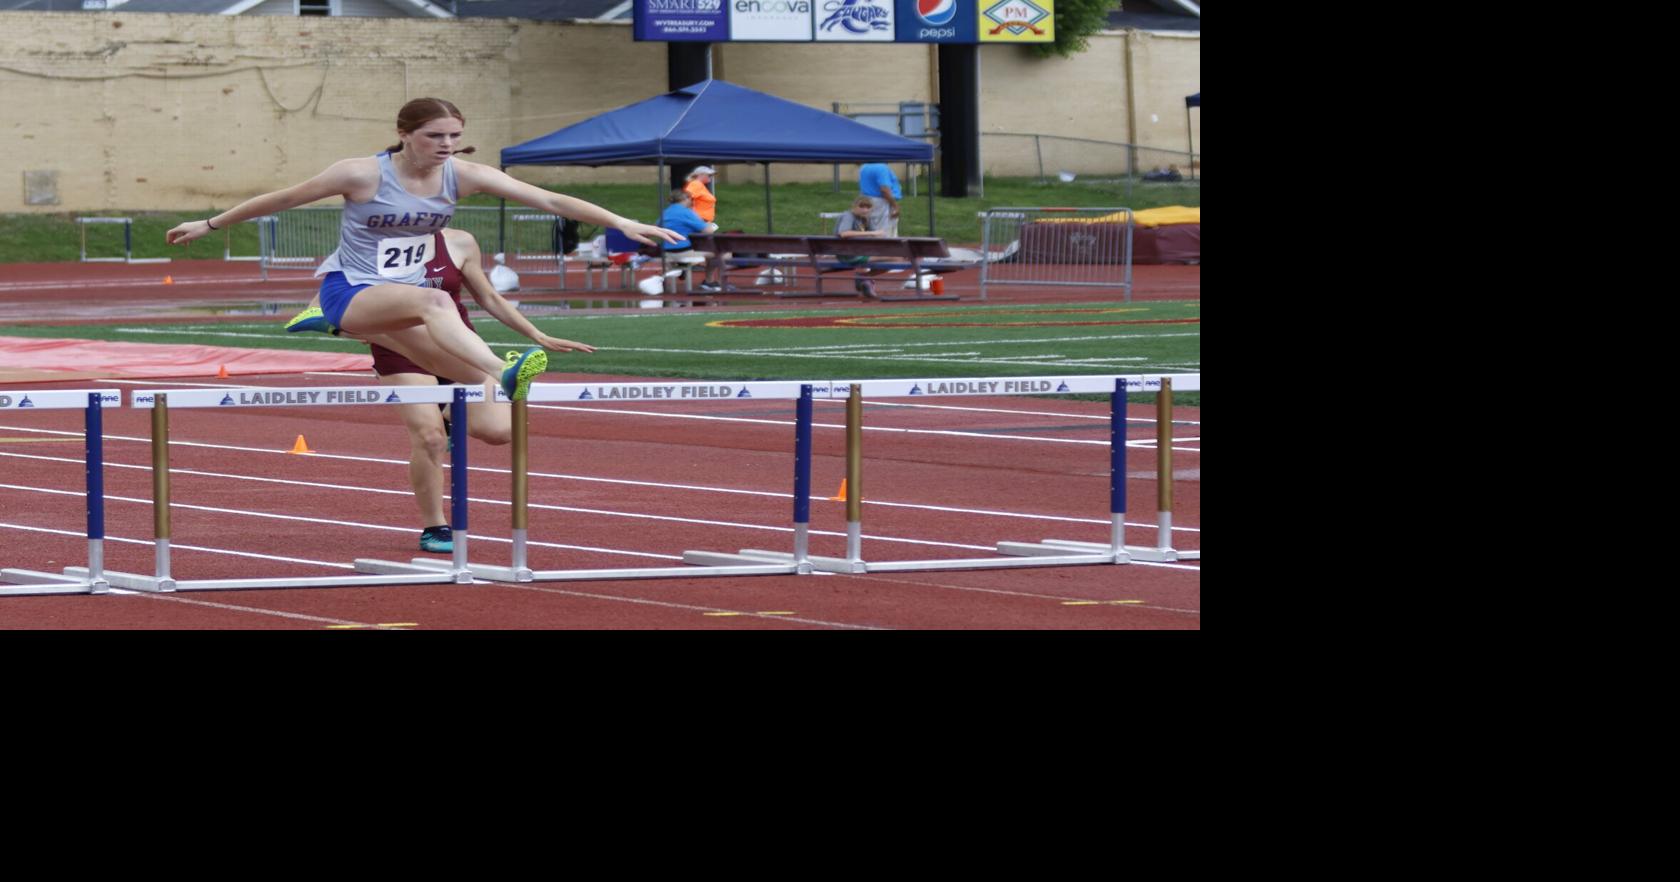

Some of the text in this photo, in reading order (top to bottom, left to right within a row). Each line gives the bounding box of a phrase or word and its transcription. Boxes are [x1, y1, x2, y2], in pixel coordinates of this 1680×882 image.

[735, 0, 809, 13] encova
[1004, 7, 1028, 18] PM
[919, 27, 956, 39] pepsi
[383, 243, 427, 268] 219
[599, 385, 732, 399] LAIDLEY FIELD
[927, 380, 1051, 394] LAIDLEY FIELD
[240, 390, 381, 405] LAIDLEY FIELD
